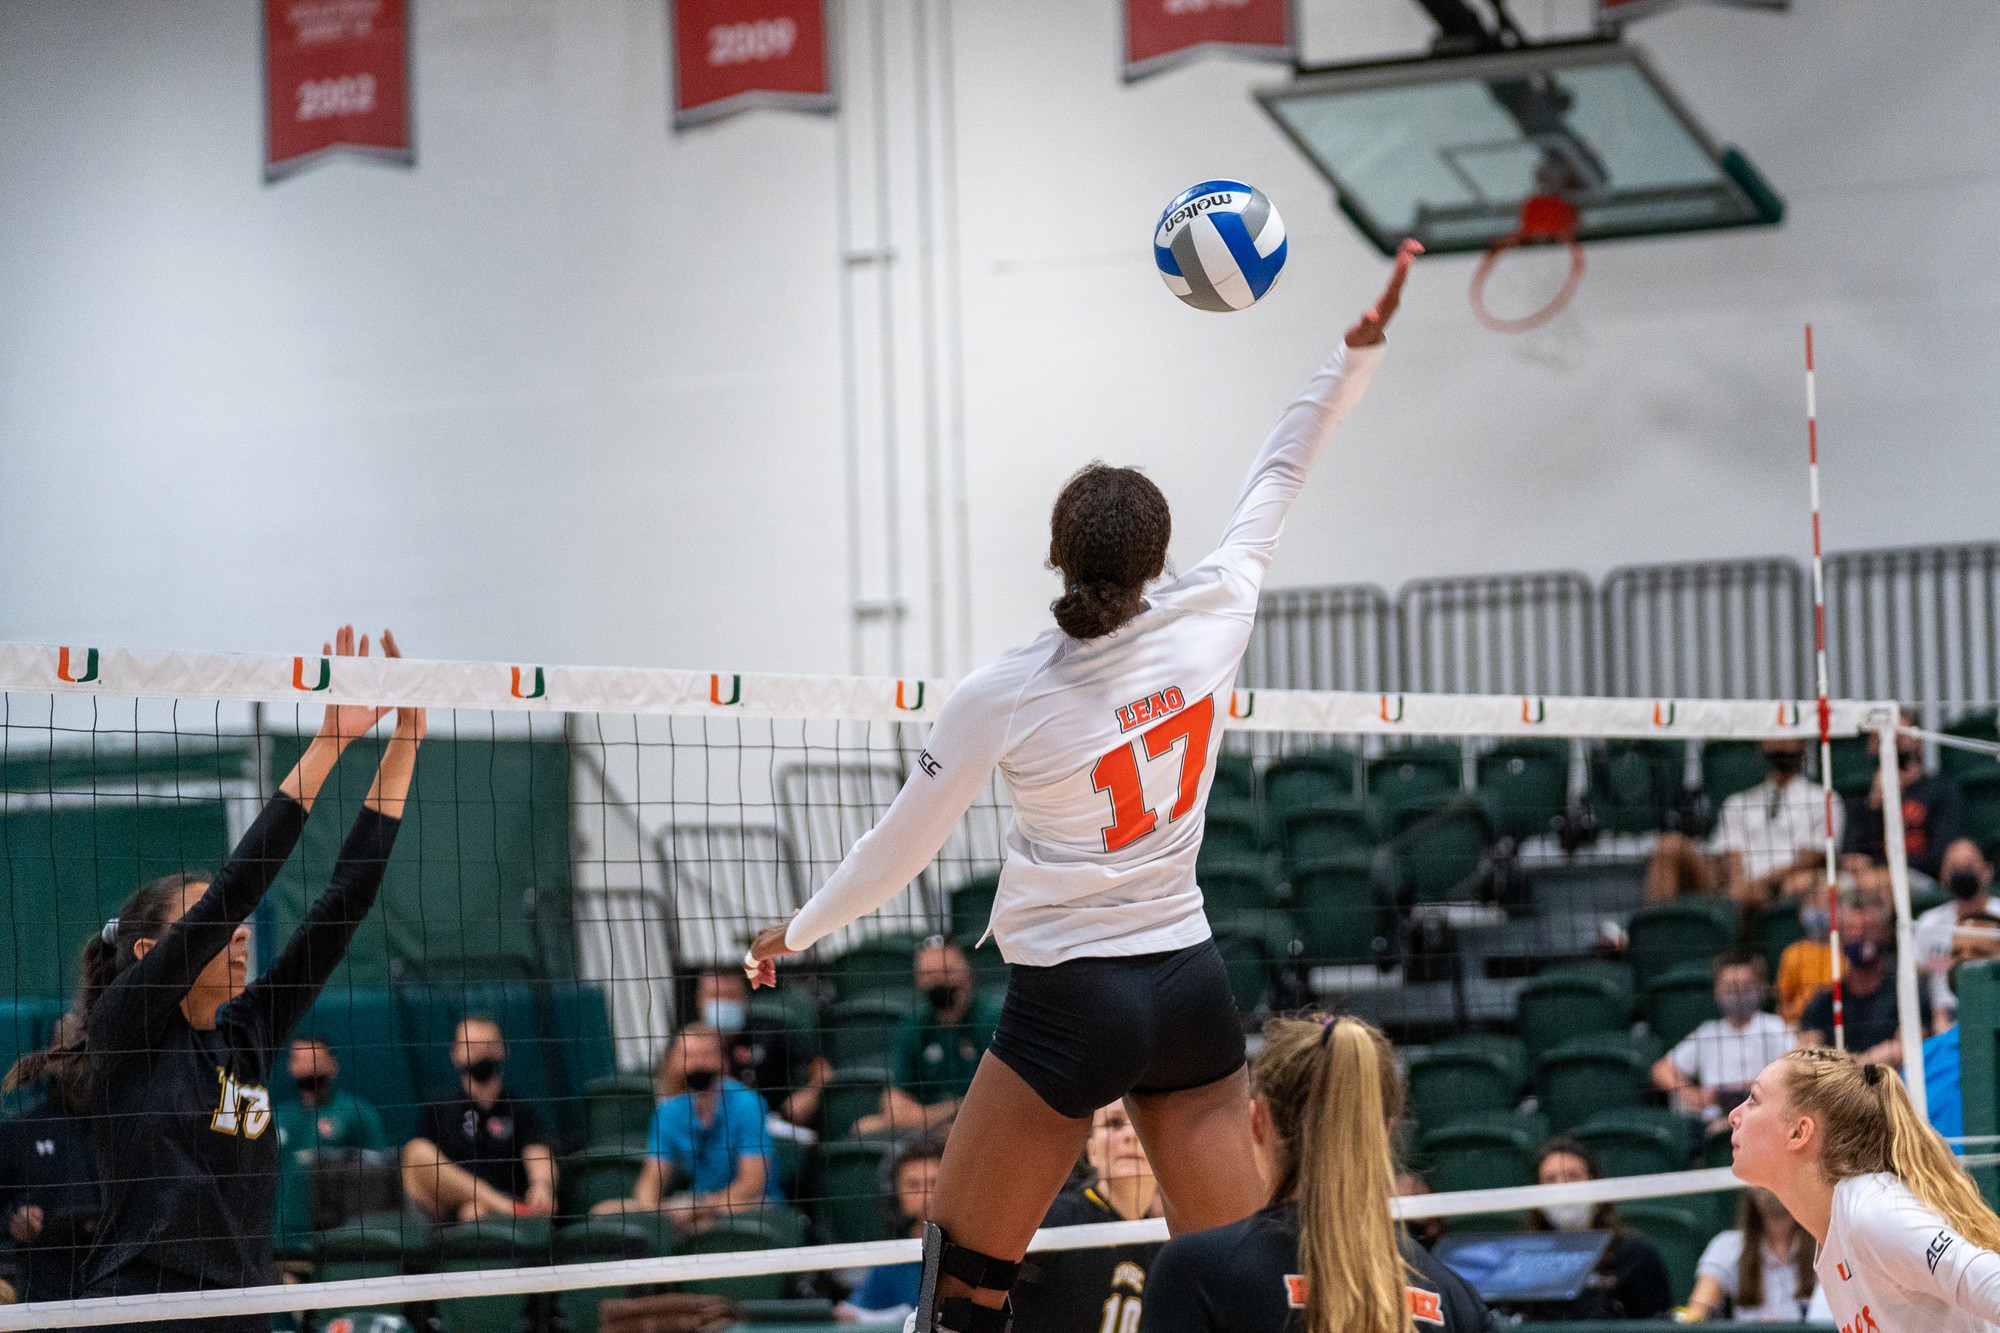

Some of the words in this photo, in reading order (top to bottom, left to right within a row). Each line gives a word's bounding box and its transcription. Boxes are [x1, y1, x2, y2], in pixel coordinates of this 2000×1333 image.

[1164, 193, 1233, 233] molten
[57, 647, 99, 683] U
[292, 656, 331, 691] U
[511, 666, 545, 699] U
[710, 674, 740, 706] U
[896, 680, 924, 710] U
[1115, 685, 1186, 734] LEAO
[1090, 692, 1215, 853] 17
[1925, 1230, 1951, 1272] ACC
